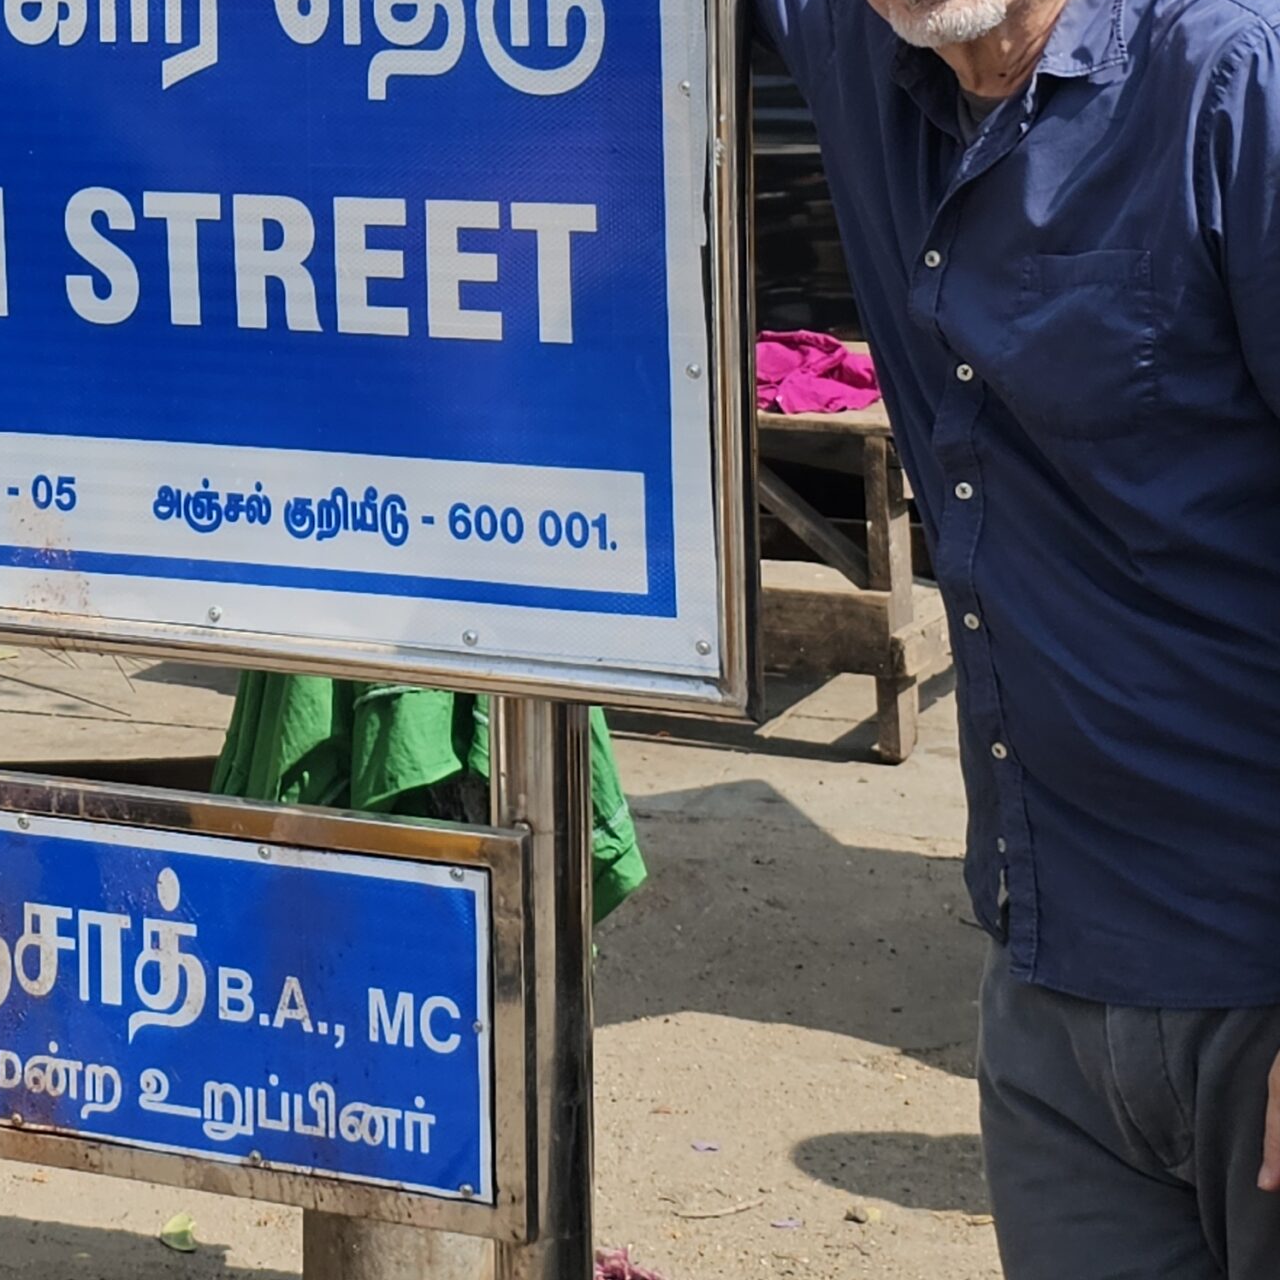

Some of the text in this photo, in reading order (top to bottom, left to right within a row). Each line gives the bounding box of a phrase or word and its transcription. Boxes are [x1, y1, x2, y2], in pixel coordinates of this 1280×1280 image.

[65, 187, 597, 343] STREET
[32, 475, 76, 511] 05
[153, 478, 271, 533] அஞ்சல்
[284, 486, 409, 546] குறியீடு
[449, 503, 524, 544] 600
[539, 510, 617, 550] 001.
[219, 967, 345, 1048] B.A.,
[368, 988, 461, 1053] MC
[139, 1068, 435, 1154] உறுப்பினர்
